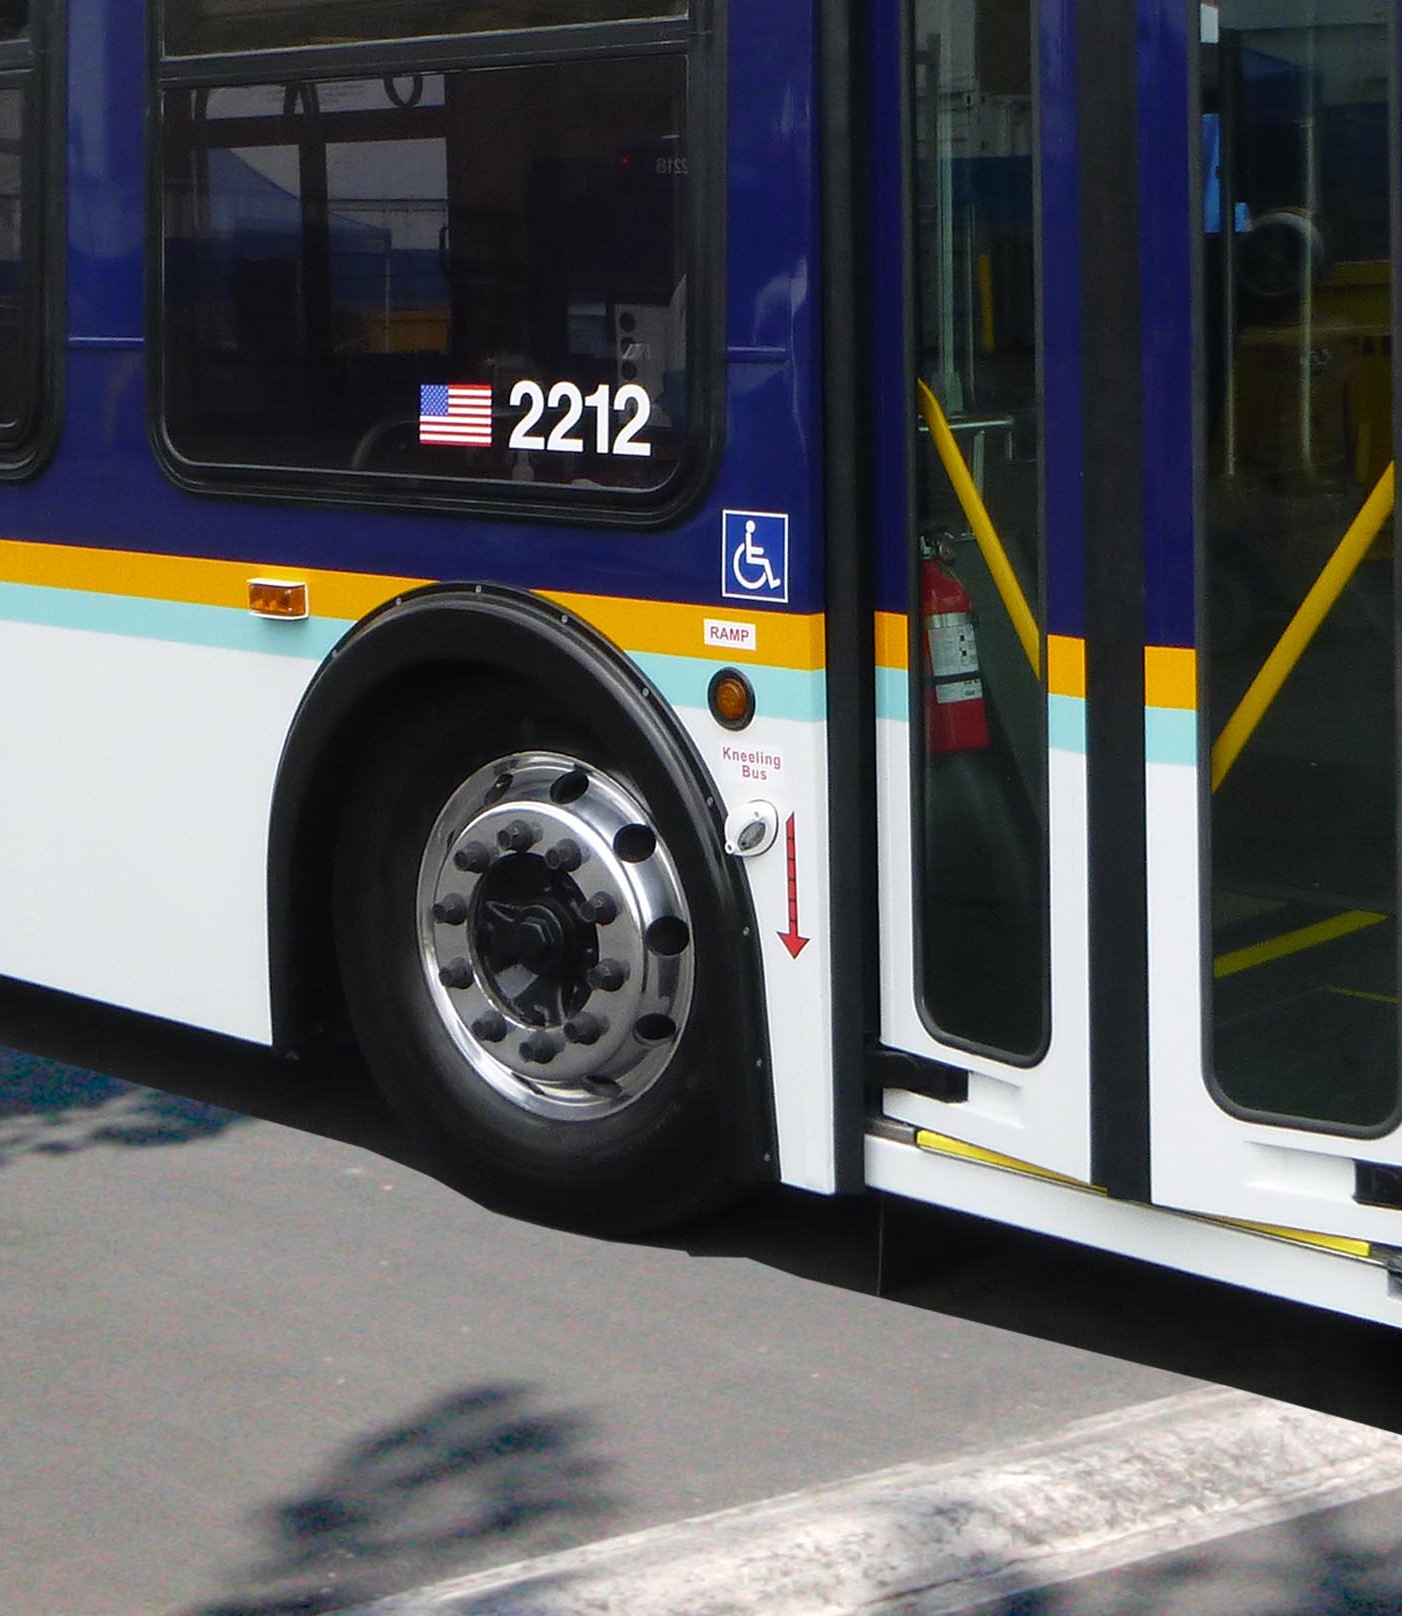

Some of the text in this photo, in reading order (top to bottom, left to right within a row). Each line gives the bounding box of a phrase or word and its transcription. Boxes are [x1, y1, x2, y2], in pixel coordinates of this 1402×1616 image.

[508, 379, 651, 457] 2212
[710, 625, 750, 643] RAMP
[722, 746, 781, 770] Kneeling
[741, 765, 767, 781] Bus
